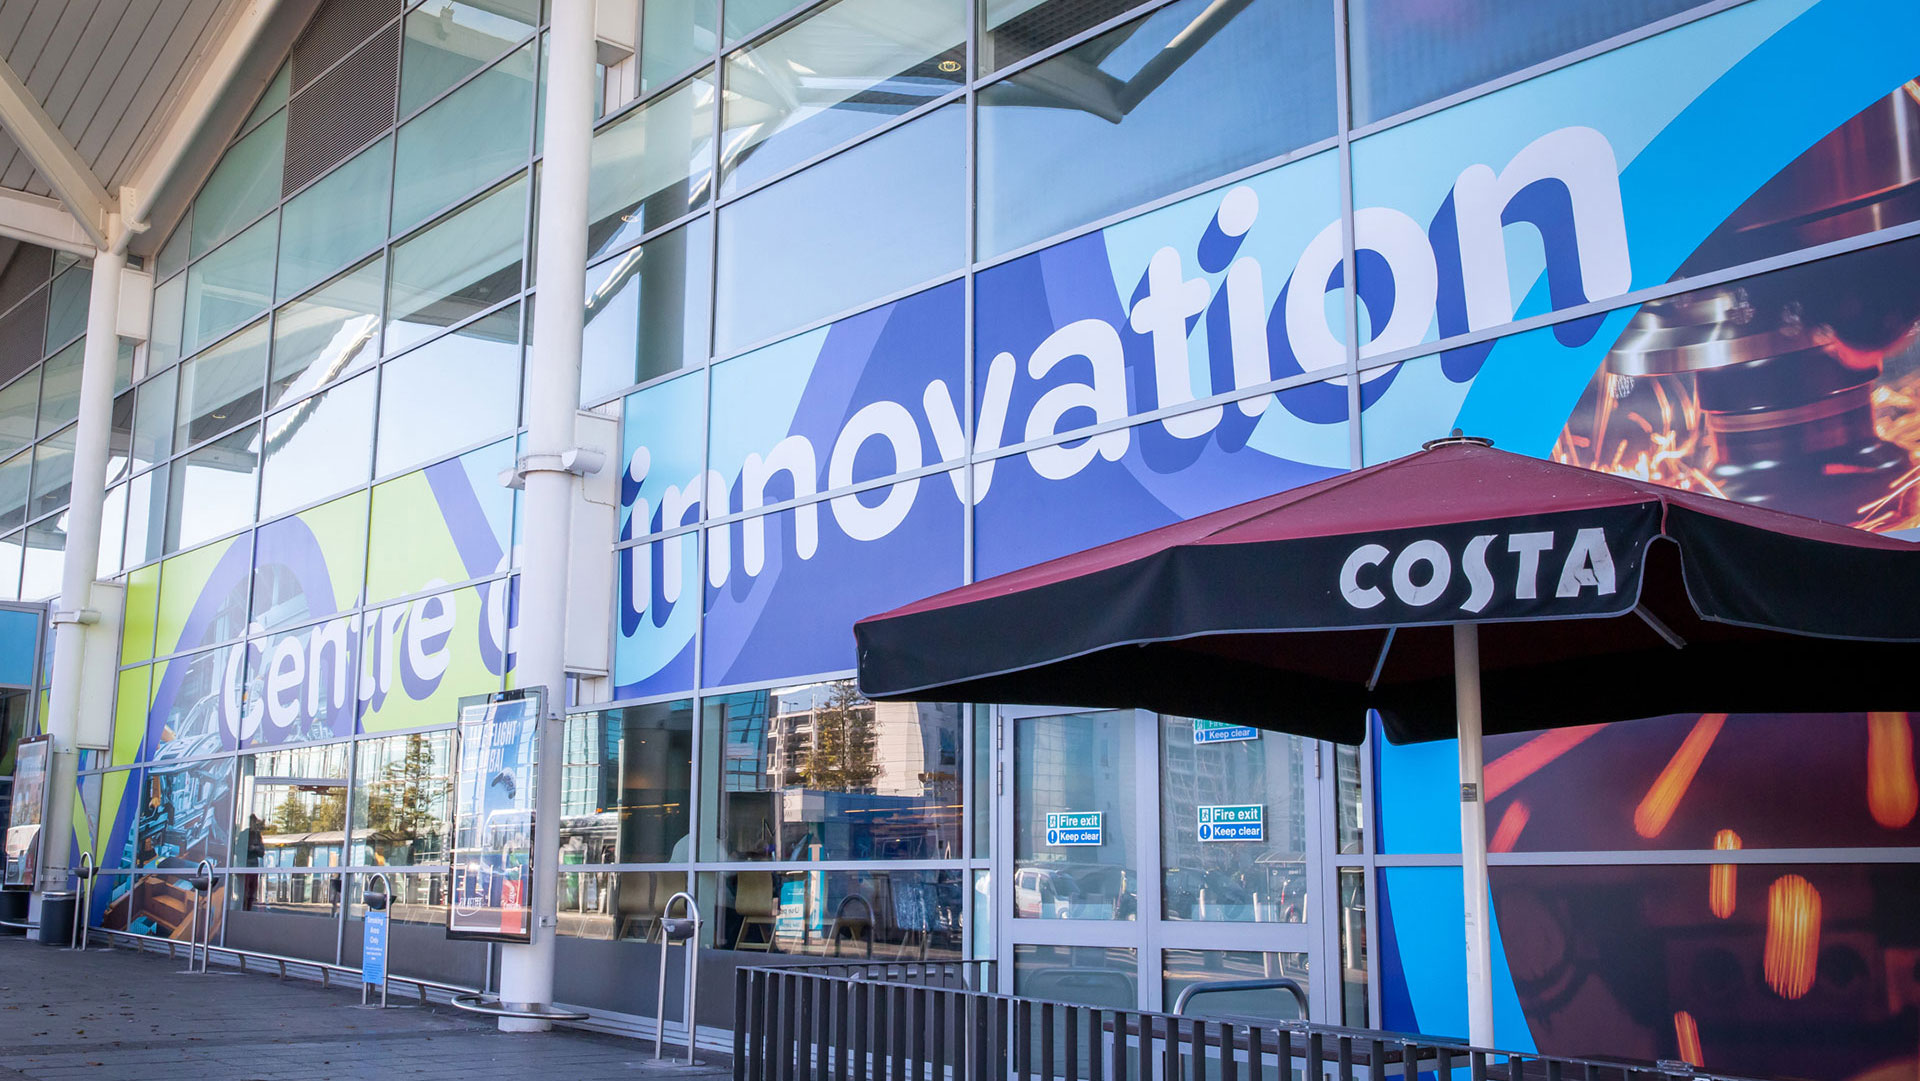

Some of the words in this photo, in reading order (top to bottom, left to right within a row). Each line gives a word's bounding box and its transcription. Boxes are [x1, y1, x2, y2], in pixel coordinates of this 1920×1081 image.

[224, 577, 457, 740] Centre
[628, 126, 1632, 613] innovation
[1339, 527, 1617, 613] COSTA
[1209, 730, 1230, 740] Keep
[1230, 729, 1251, 737] clear
[1214, 808, 1235, 820] Fire
[1237, 807, 1258, 820] exit
[1060, 815, 1079, 826] Fire
[1080, 814, 1098, 826] exit
[1060, 831, 1079, 842] Keep
[1080, 831, 1099, 841] clear
[1214, 826, 1237, 838] Keep
[1238, 826, 1260, 836] clear
